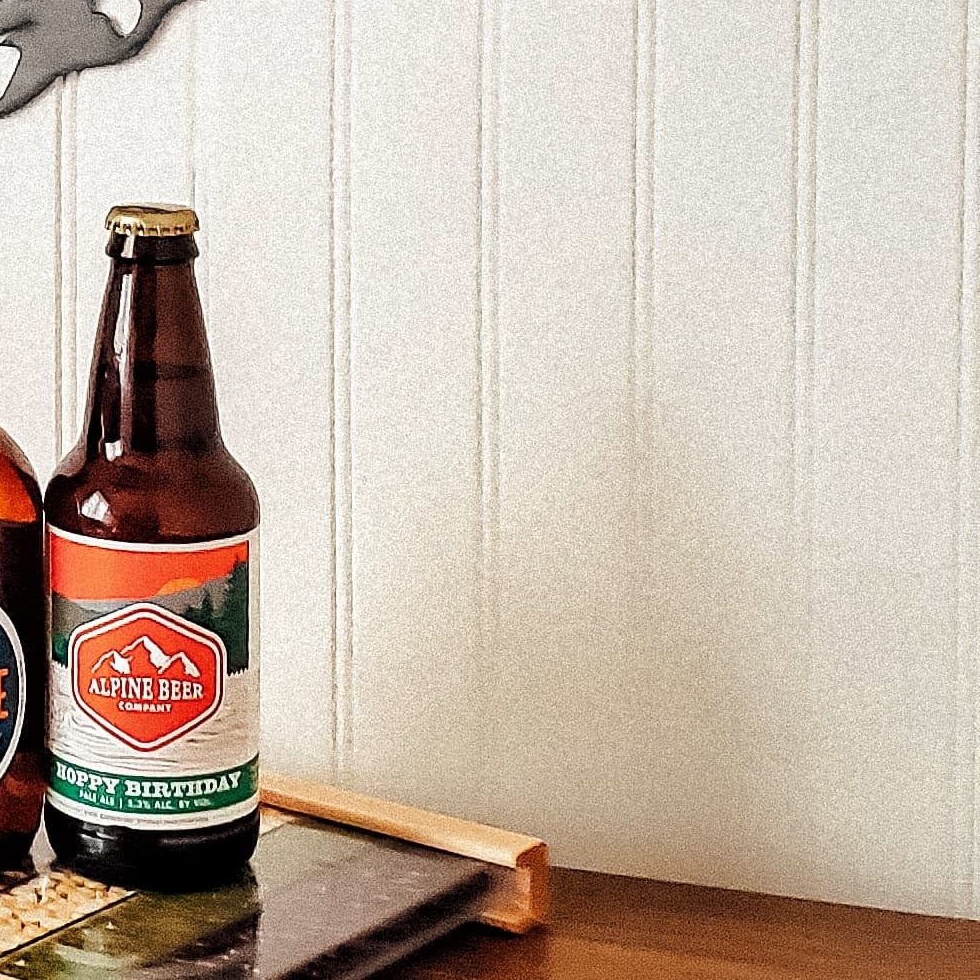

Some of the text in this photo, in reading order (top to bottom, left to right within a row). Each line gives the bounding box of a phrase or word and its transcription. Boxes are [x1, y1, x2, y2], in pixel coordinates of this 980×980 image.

[88, 677, 204, 701] ALPINE BEER
[118, 701, 172, 713] COMPANY
[56, 761, 242, 798] HOPPY BIRTHDAY
